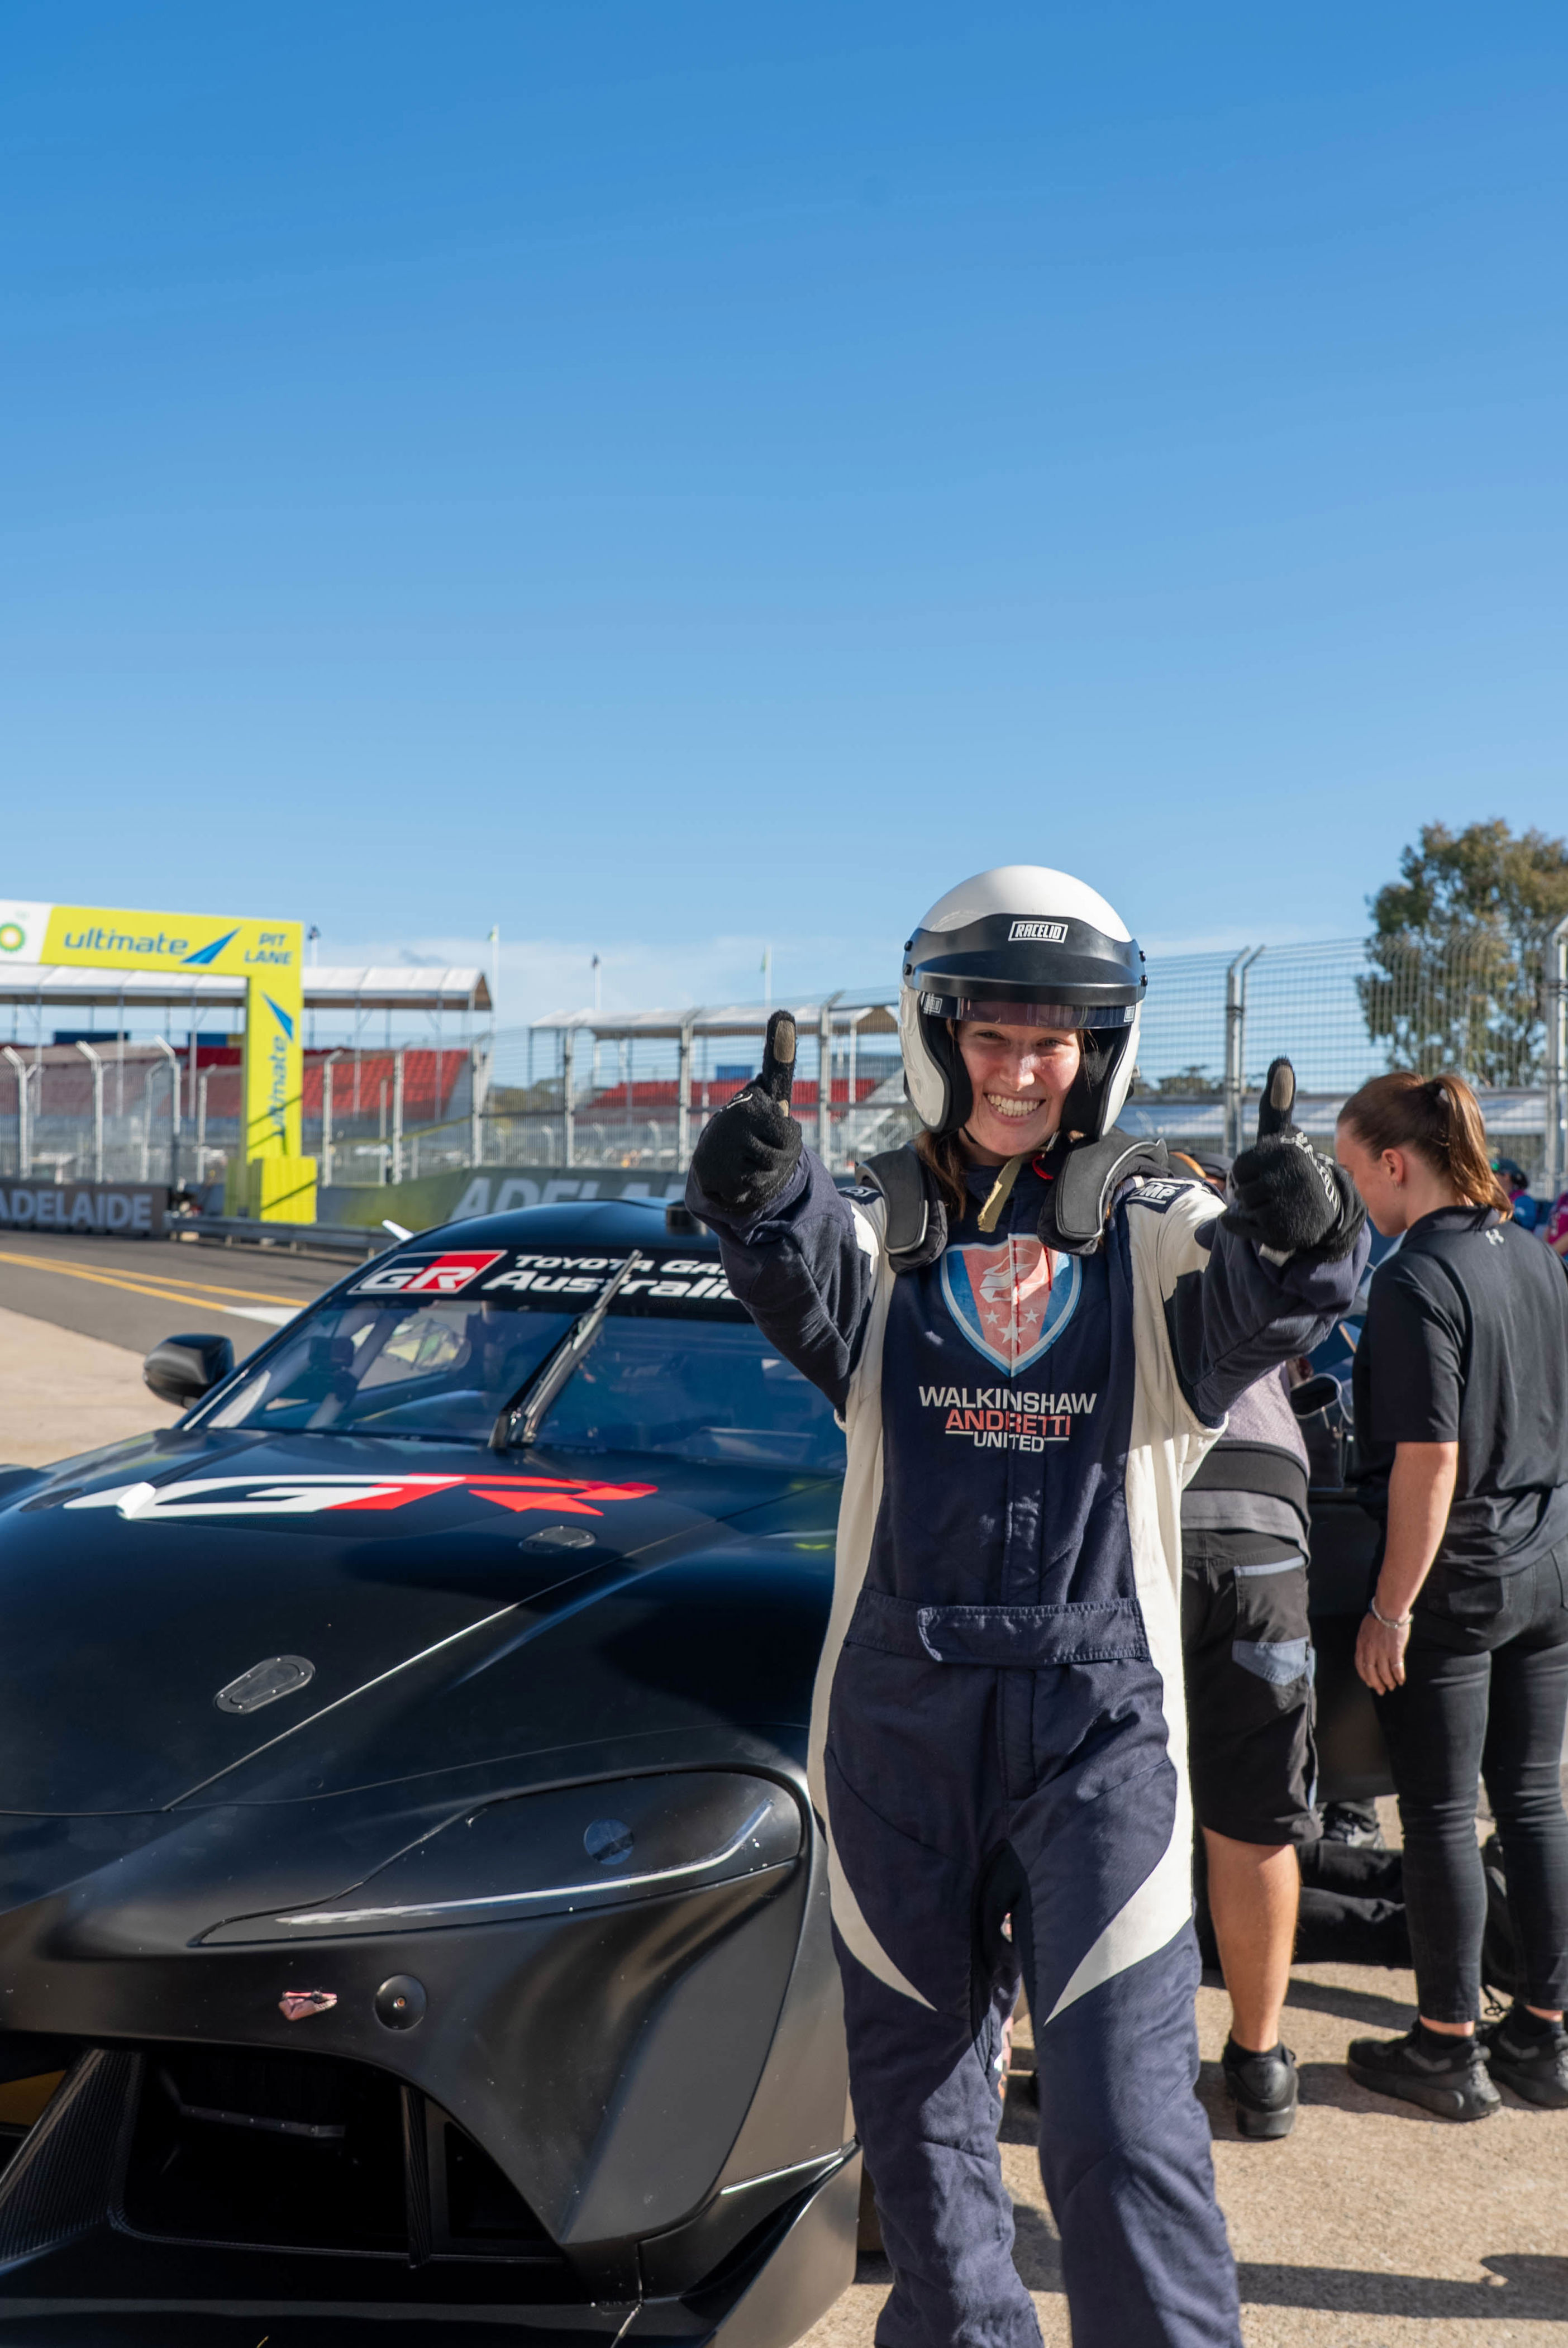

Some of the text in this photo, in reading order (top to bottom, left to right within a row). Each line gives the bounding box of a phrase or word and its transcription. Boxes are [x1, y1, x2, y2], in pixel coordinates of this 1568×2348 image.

[64, 928, 189, 956] ultimate
[258, 932, 287, 947] PIT
[244, 950, 292, 966] LANE
[360, 1266, 477, 1290] GR
[660, 1260, 725, 1275] GA
[919, 1386, 1097, 1414] WALKINSHAW
[945, 1409, 1071, 1436] ANDRETTI
[974, 1431, 1045, 1452] UNITED
